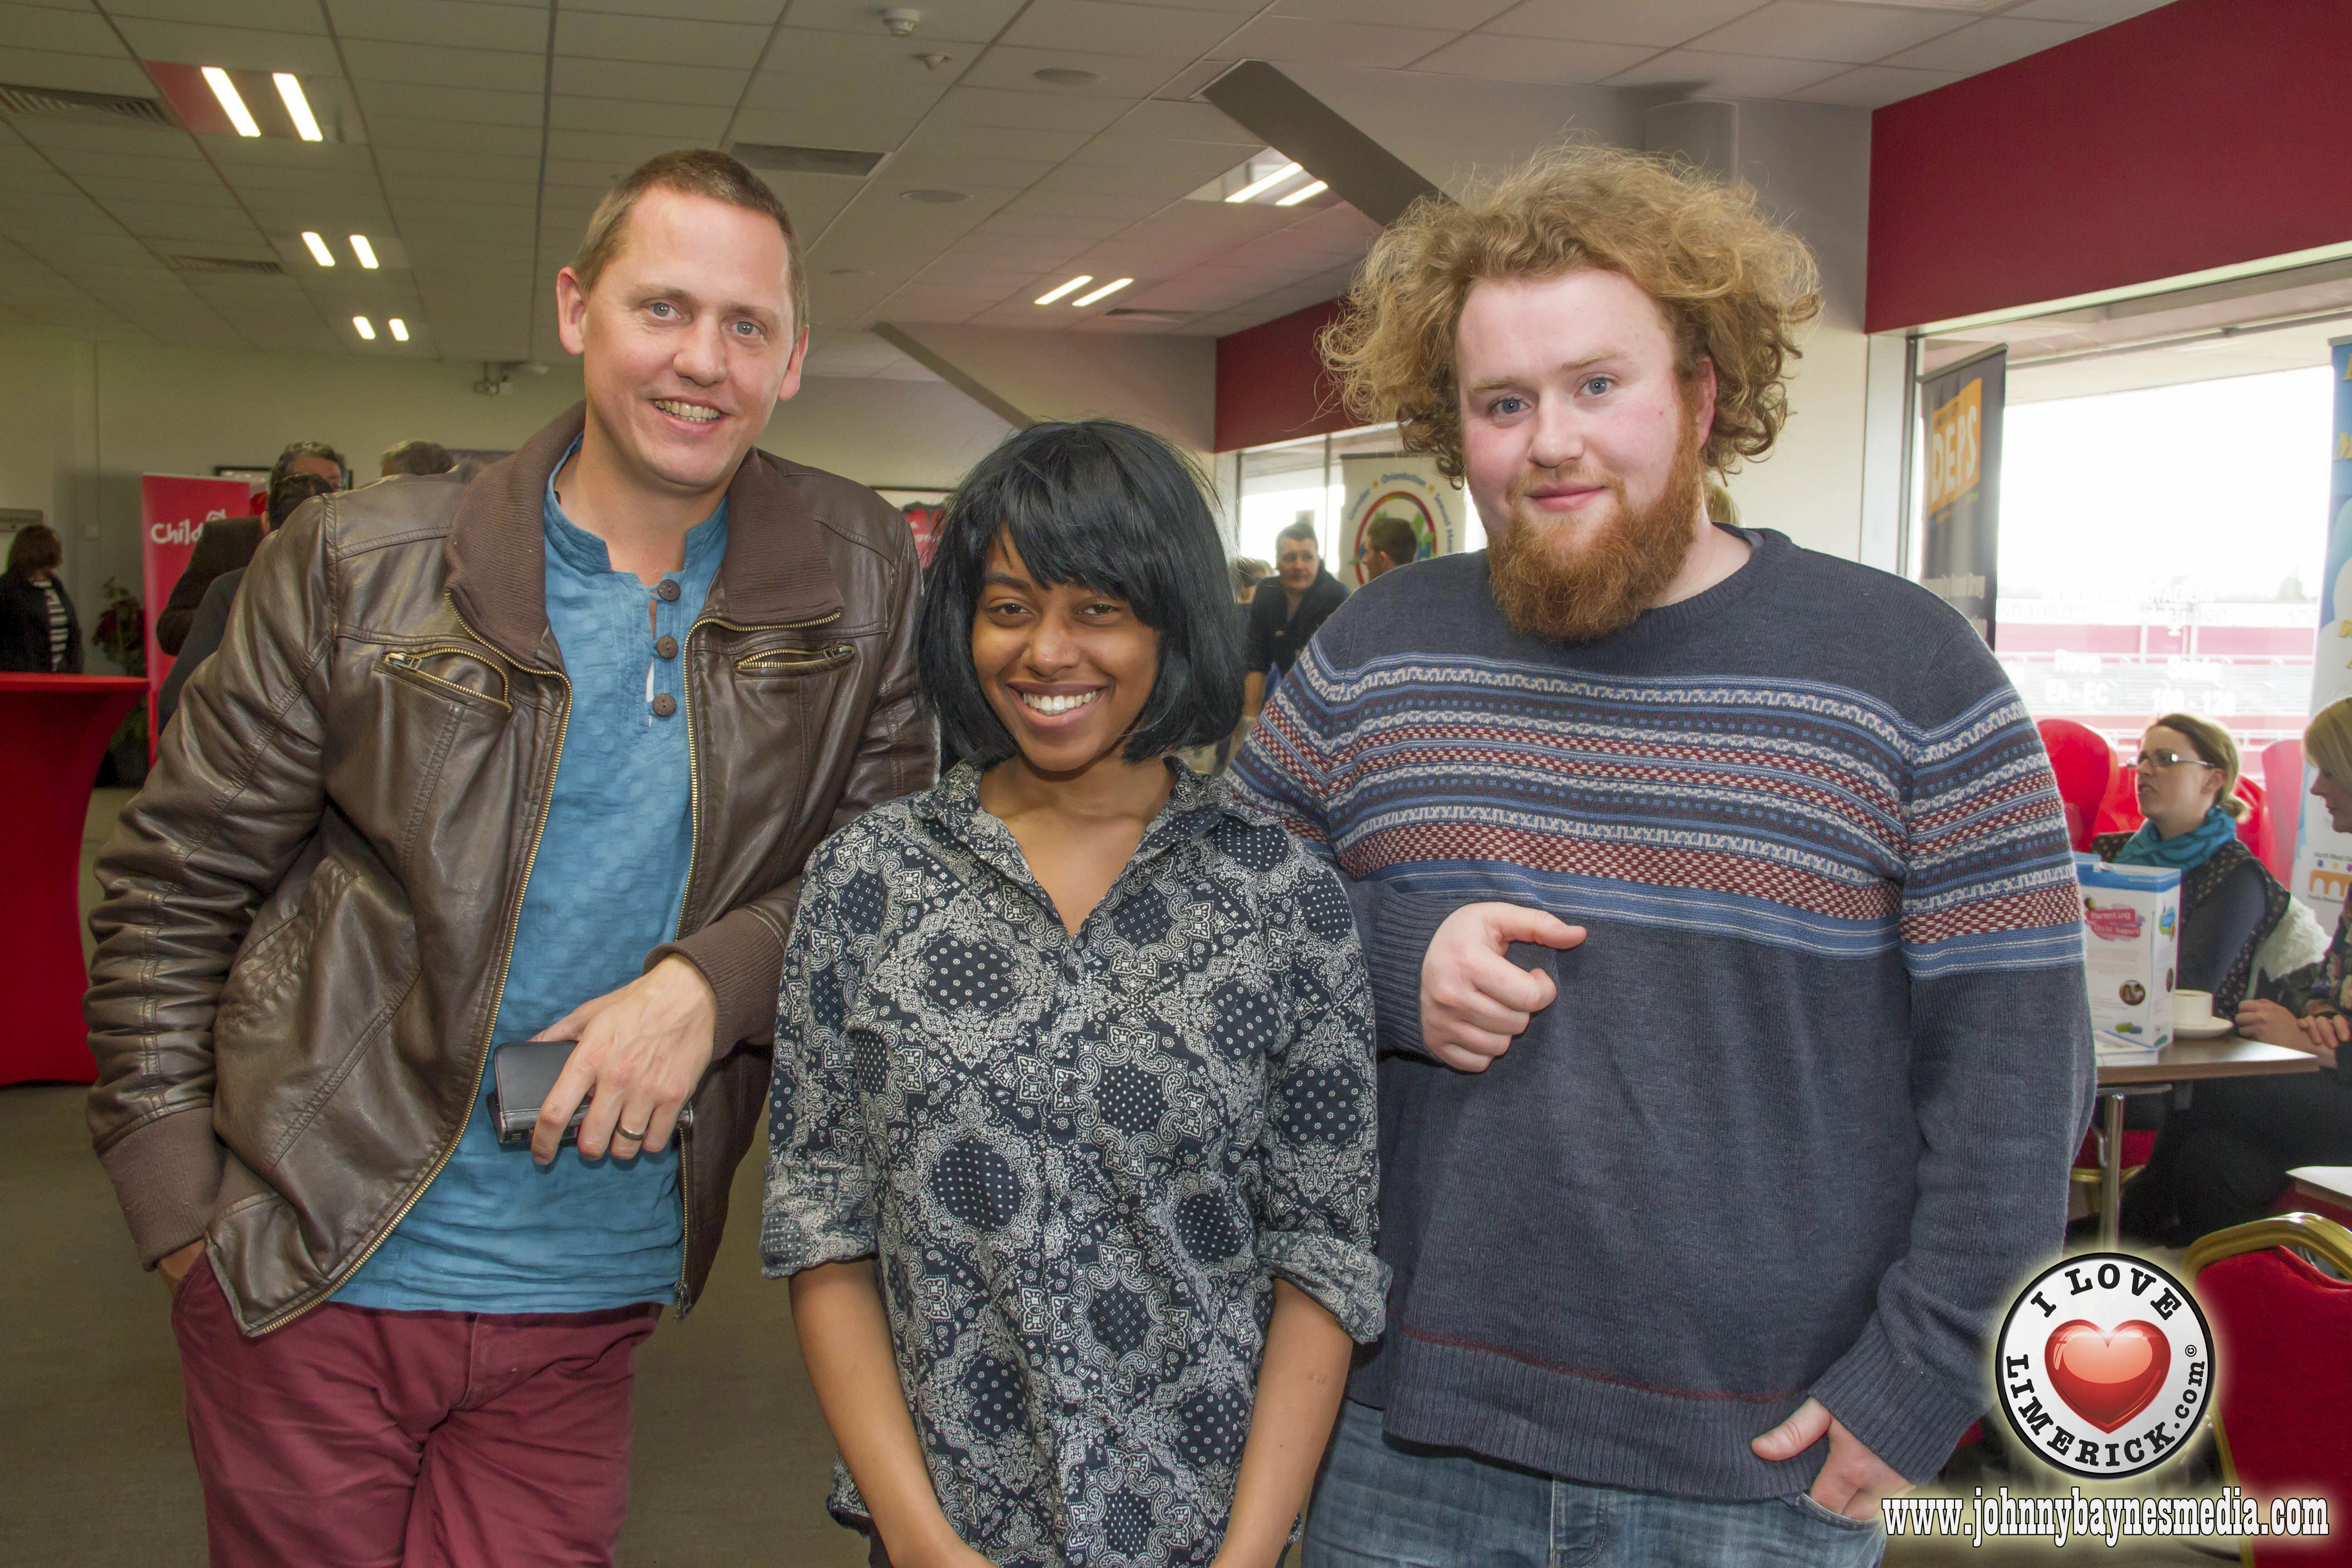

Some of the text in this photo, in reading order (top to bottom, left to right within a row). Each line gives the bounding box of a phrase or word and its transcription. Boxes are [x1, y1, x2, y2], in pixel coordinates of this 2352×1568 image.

[150, 519, 204, 544] Child
[2054, 649, 2102, 673] Rows
[2091, 911, 2130, 921] Parenting
